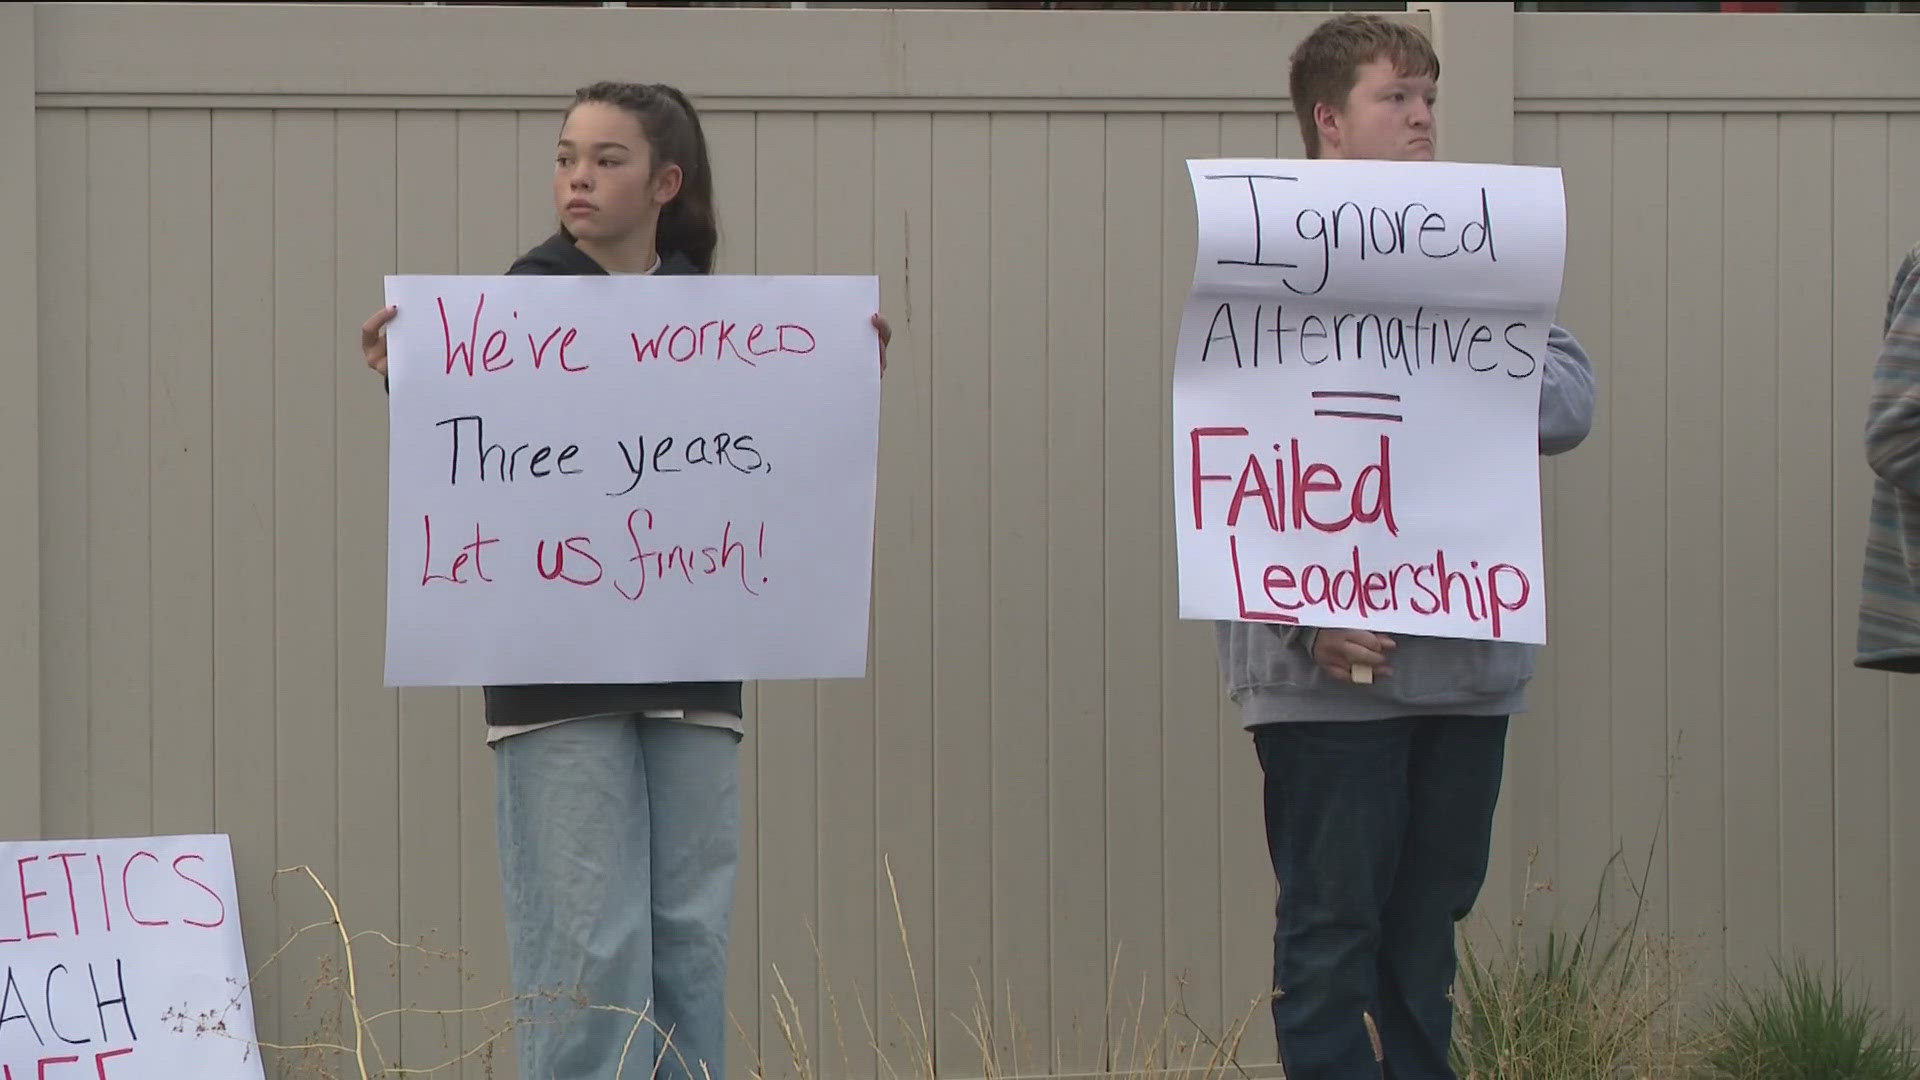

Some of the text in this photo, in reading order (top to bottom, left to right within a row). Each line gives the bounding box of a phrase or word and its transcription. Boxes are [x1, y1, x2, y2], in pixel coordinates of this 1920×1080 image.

[1204, 174, 1497, 295] Ignored
[436, 293, 590, 376] We've
[1202, 303, 1536, 378] Alternatives
[435, 415, 584, 486] Three
[422, 508, 769, 601] Let us finish!
[1229, 534, 1531, 638] Leadership
